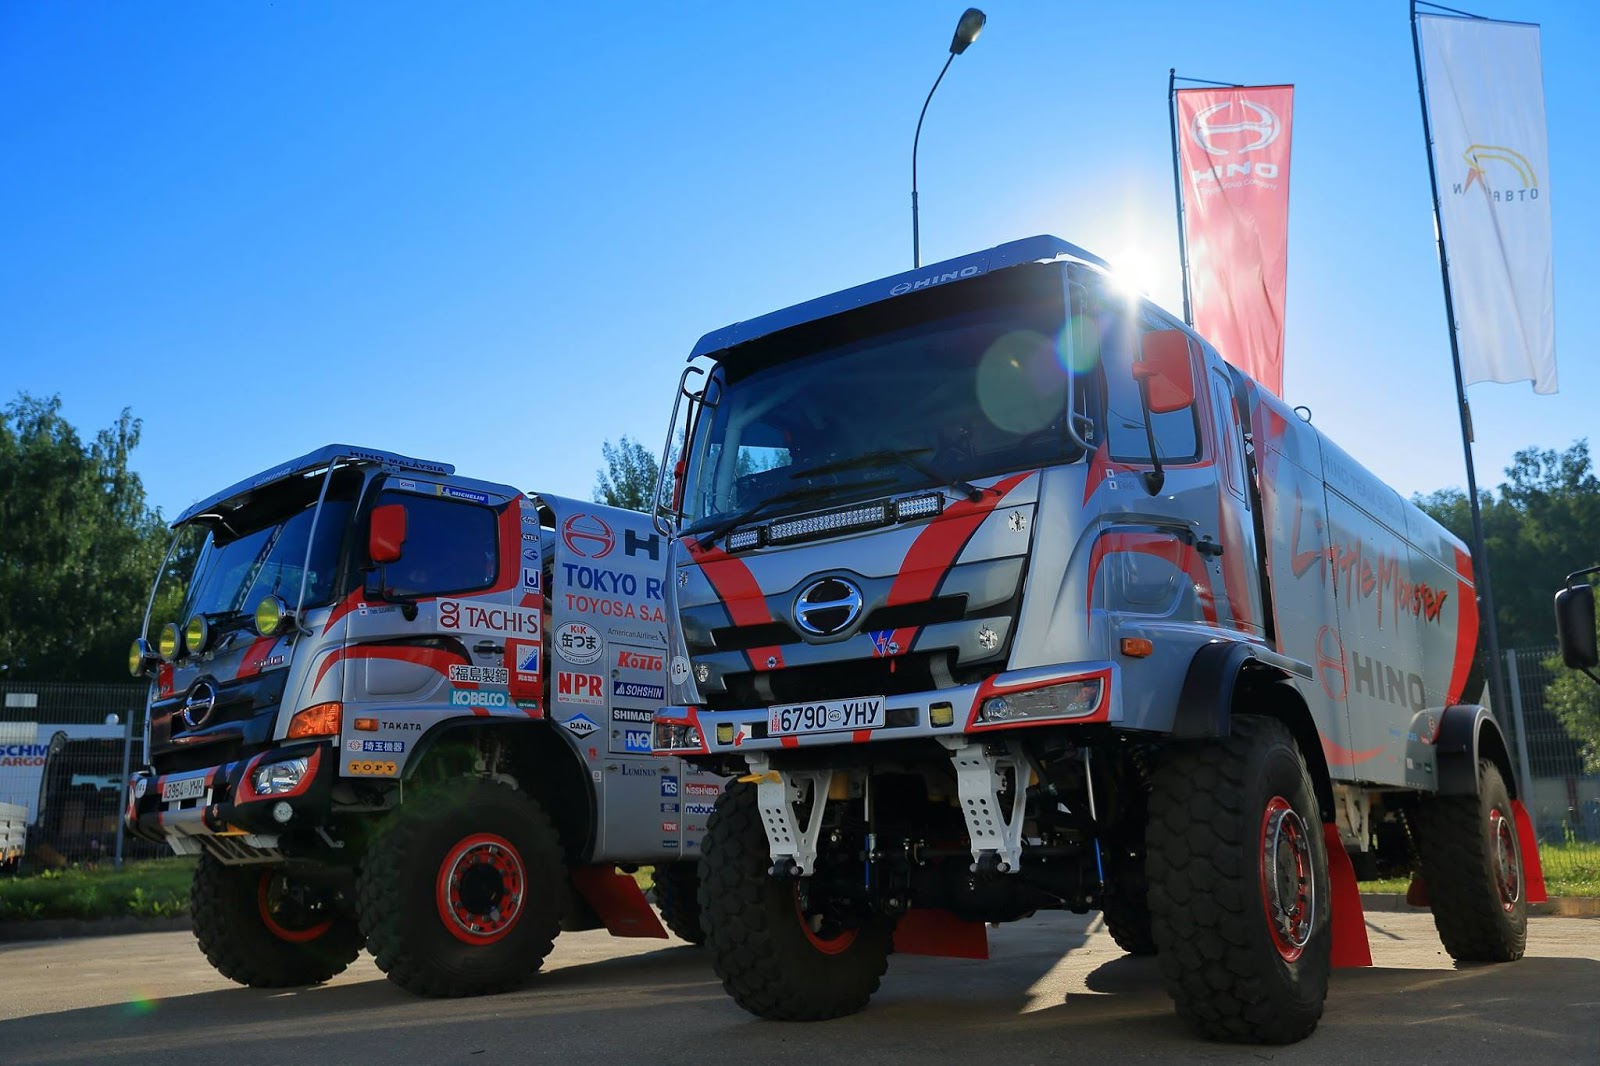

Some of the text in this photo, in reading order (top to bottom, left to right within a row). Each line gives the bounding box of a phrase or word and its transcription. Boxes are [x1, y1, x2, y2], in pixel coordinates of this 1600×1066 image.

[1193, 161, 1278, 183] HINO
[914, 265, 979, 290] HINO
[350, 451, 385, 463] HINO
[388, 457, 445, 473] MALAYSIA
[451, 490, 485, 501] MICHELIN
[562, 562, 637, 596] TOKYO
[565, 593, 667, 623] TOYOSA S.A.
[465, 607, 538, 634] TACHI-S
[561, 632, 597, 649] 缶つま
[456, 667, 508, 684] 福島製鋼
[1352, 651, 1426, 713] HINO
[558, 672, 603, 697] NPR
[626, 685, 663, 699] SOHSHIN
[452, 690, 506, 708] KOBELCO
[382, 721, 422, 731] TAKATA
[570, 722, 592, 731] DANA
[781, 705, 827, 731] 6790
[364, 741, 402, 752] 埼玉機器
[627, 732, 650, 748] NO
[1, 757, 44, 766] ARGO
[351, 764, 395, 772] TOPY
[663, 823, 677, 831] TONE
